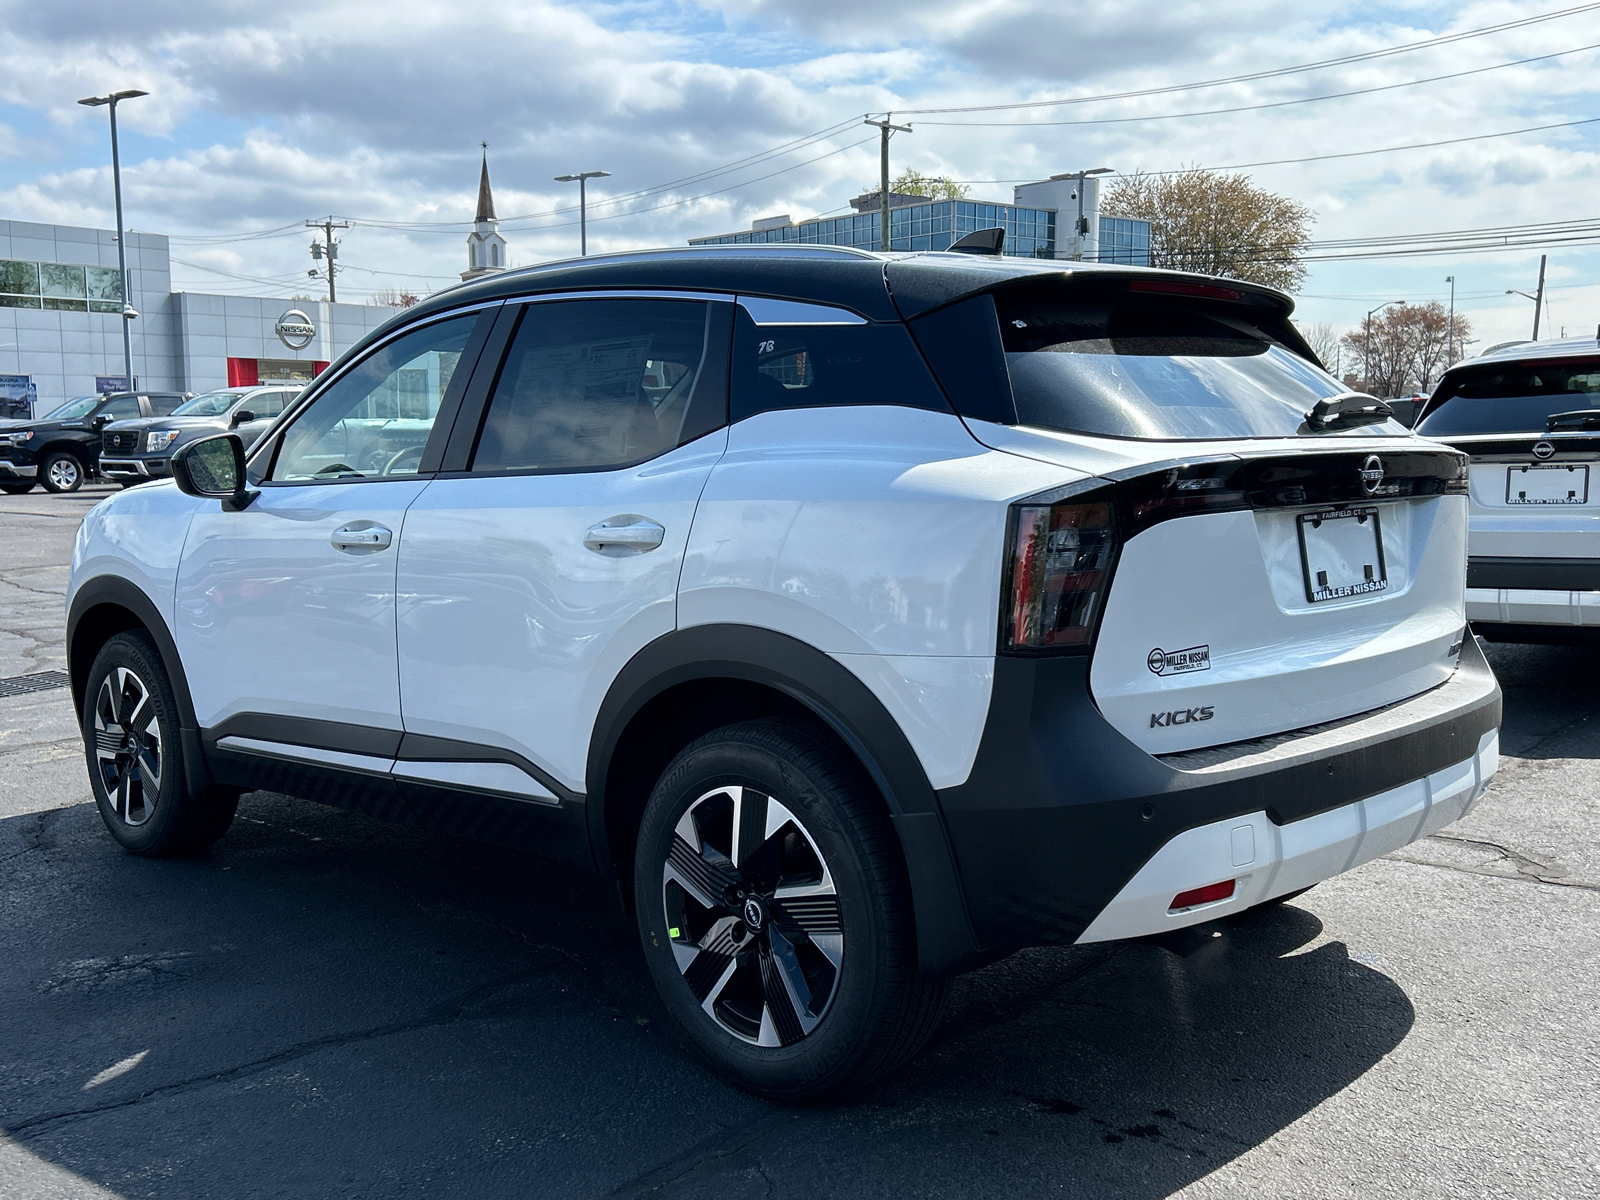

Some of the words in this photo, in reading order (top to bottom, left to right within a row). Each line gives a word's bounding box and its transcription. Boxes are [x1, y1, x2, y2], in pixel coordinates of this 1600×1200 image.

[280, 325, 314, 333] NISSAN
[824, 354, 863, 365] KICKS
[1362, 471, 1383, 480] NISSA
[1322, 510, 1352, 519] FAIRFIELD,
[1314, 586, 1352, 602] MILLER
[1353, 580, 1388, 594] NISSAN
[1166, 654, 1188, 667] MILLER
[1188, 651, 1209, 663] NISSAN
[129, 650, 165, 725] BRIDGESTONE
[1149, 705, 1215, 728] KICKS
